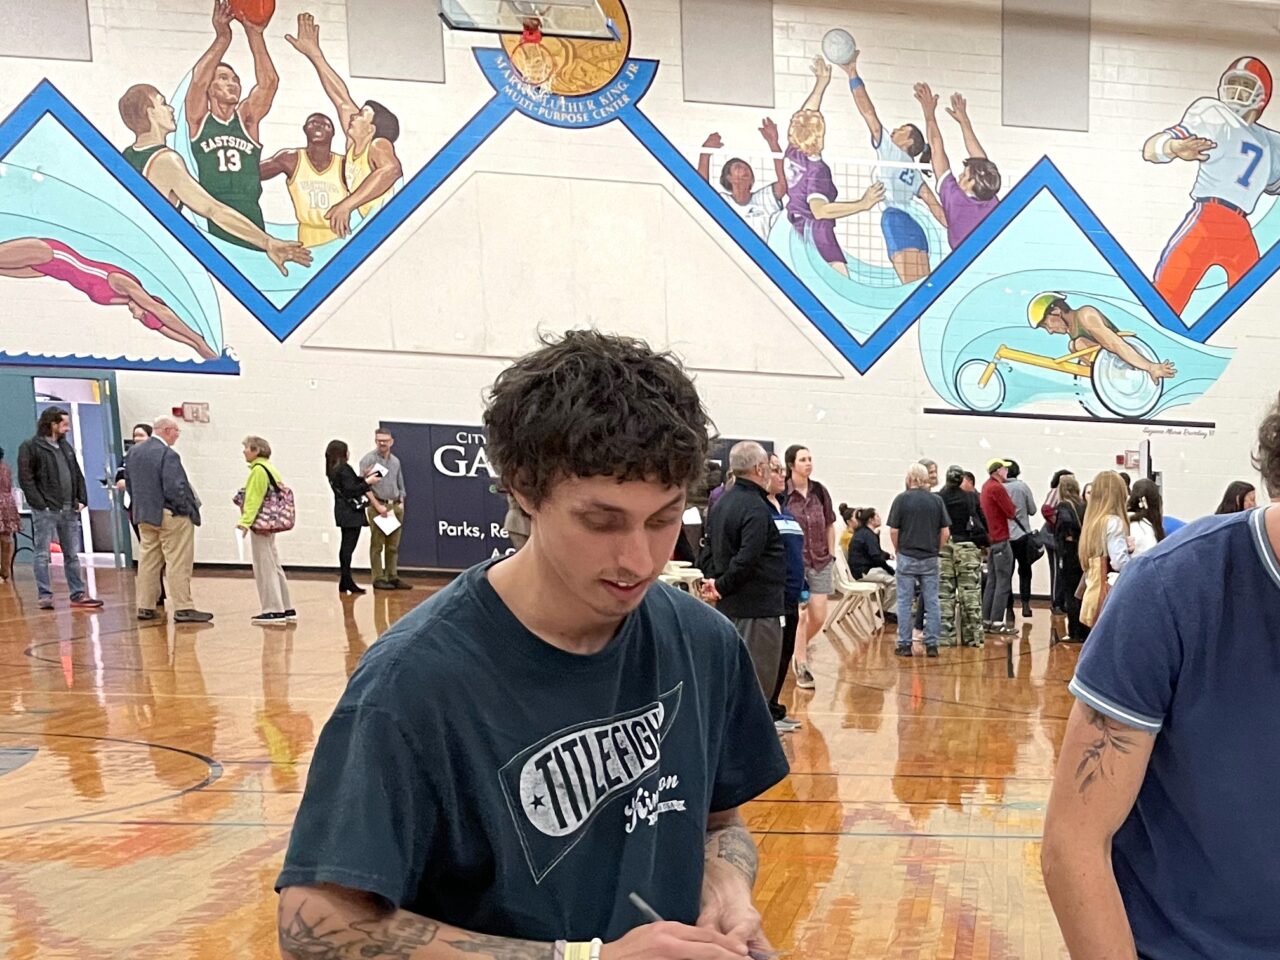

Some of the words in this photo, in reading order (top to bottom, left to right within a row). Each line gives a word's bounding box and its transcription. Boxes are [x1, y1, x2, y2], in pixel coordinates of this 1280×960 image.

[598, 81, 629, 106] KING
[624, 62, 641, 82] JR
[503, 84, 590, 123] MULTI-PURPOSE
[592, 94, 632, 121] CENTER
[200, 135, 255, 155] EASTSIDE
[217, 149, 242, 172] 13
[1236, 140, 1264, 188] 7
[309, 190, 329, 210] 10
[433, 445, 500, 478] GA
[438, 520, 485, 540] Parks,
[534, 709, 661, 831] TITLEFIGH
